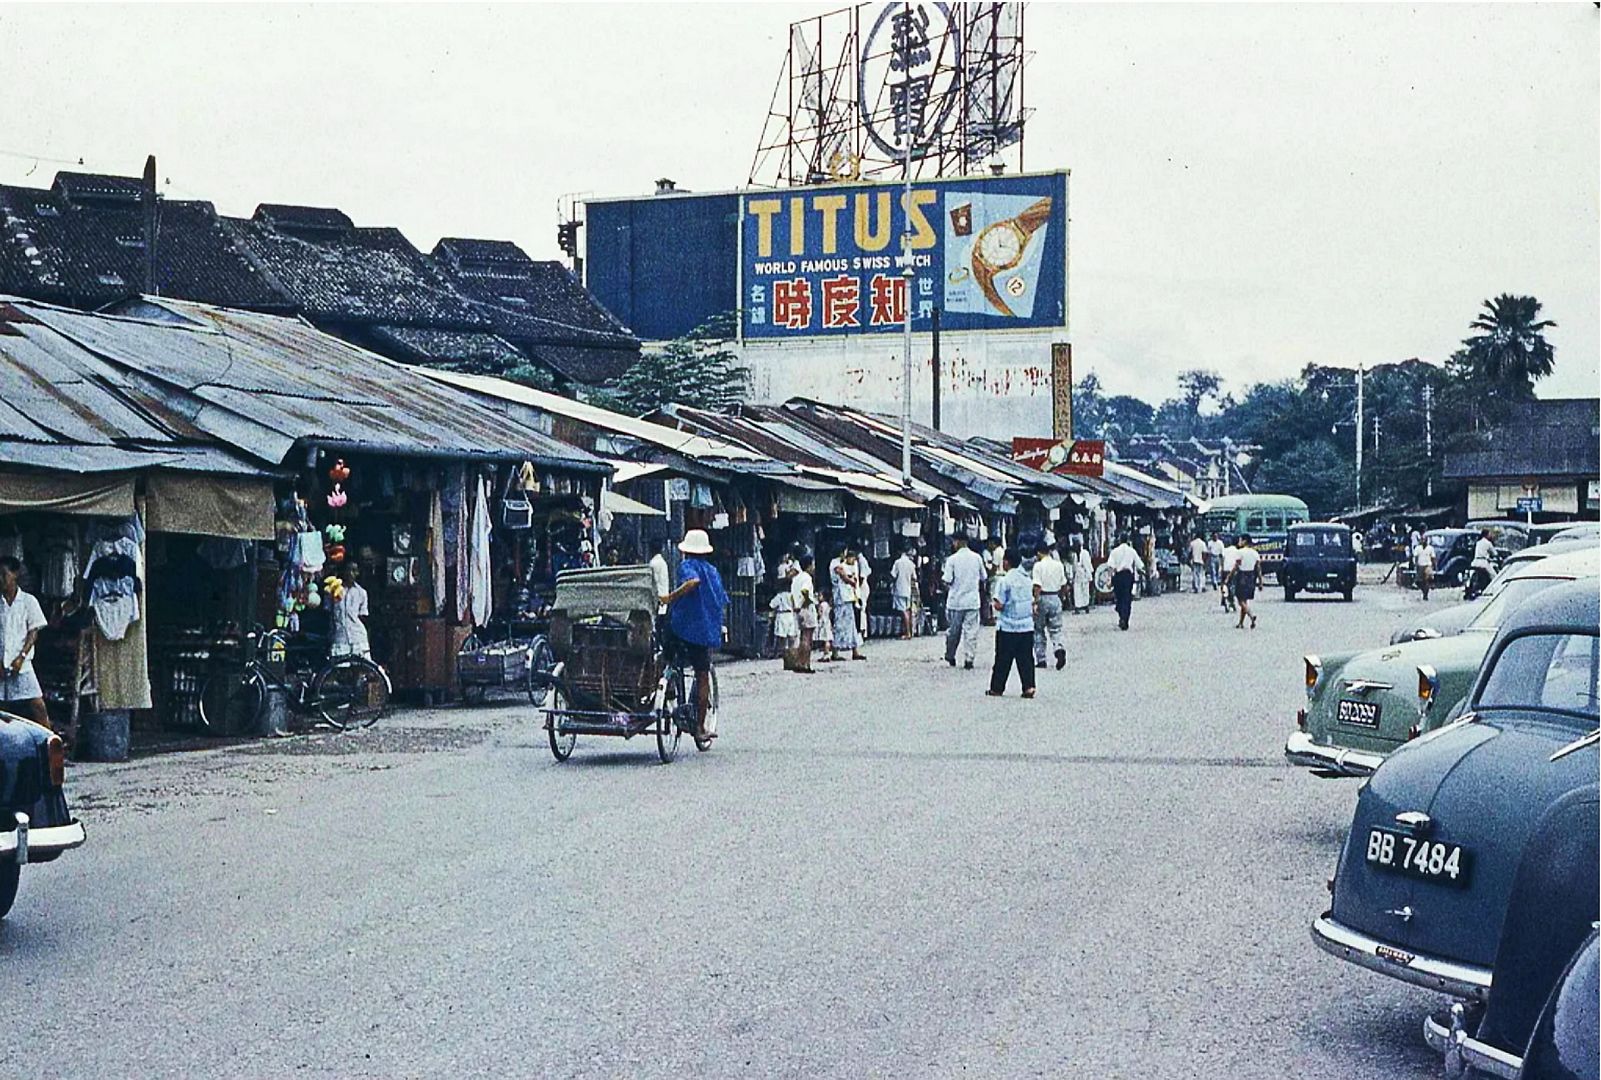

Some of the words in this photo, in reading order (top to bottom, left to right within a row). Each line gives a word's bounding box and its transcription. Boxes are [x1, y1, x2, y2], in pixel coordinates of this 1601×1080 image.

[748, 189, 937, 257] TITUS
[755, 261, 797, 275] WORLD
[801, 258, 849, 273] FAMOUS
[853, 255, 890, 269] SWISS
[894, 254, 931, 268] WTCH
